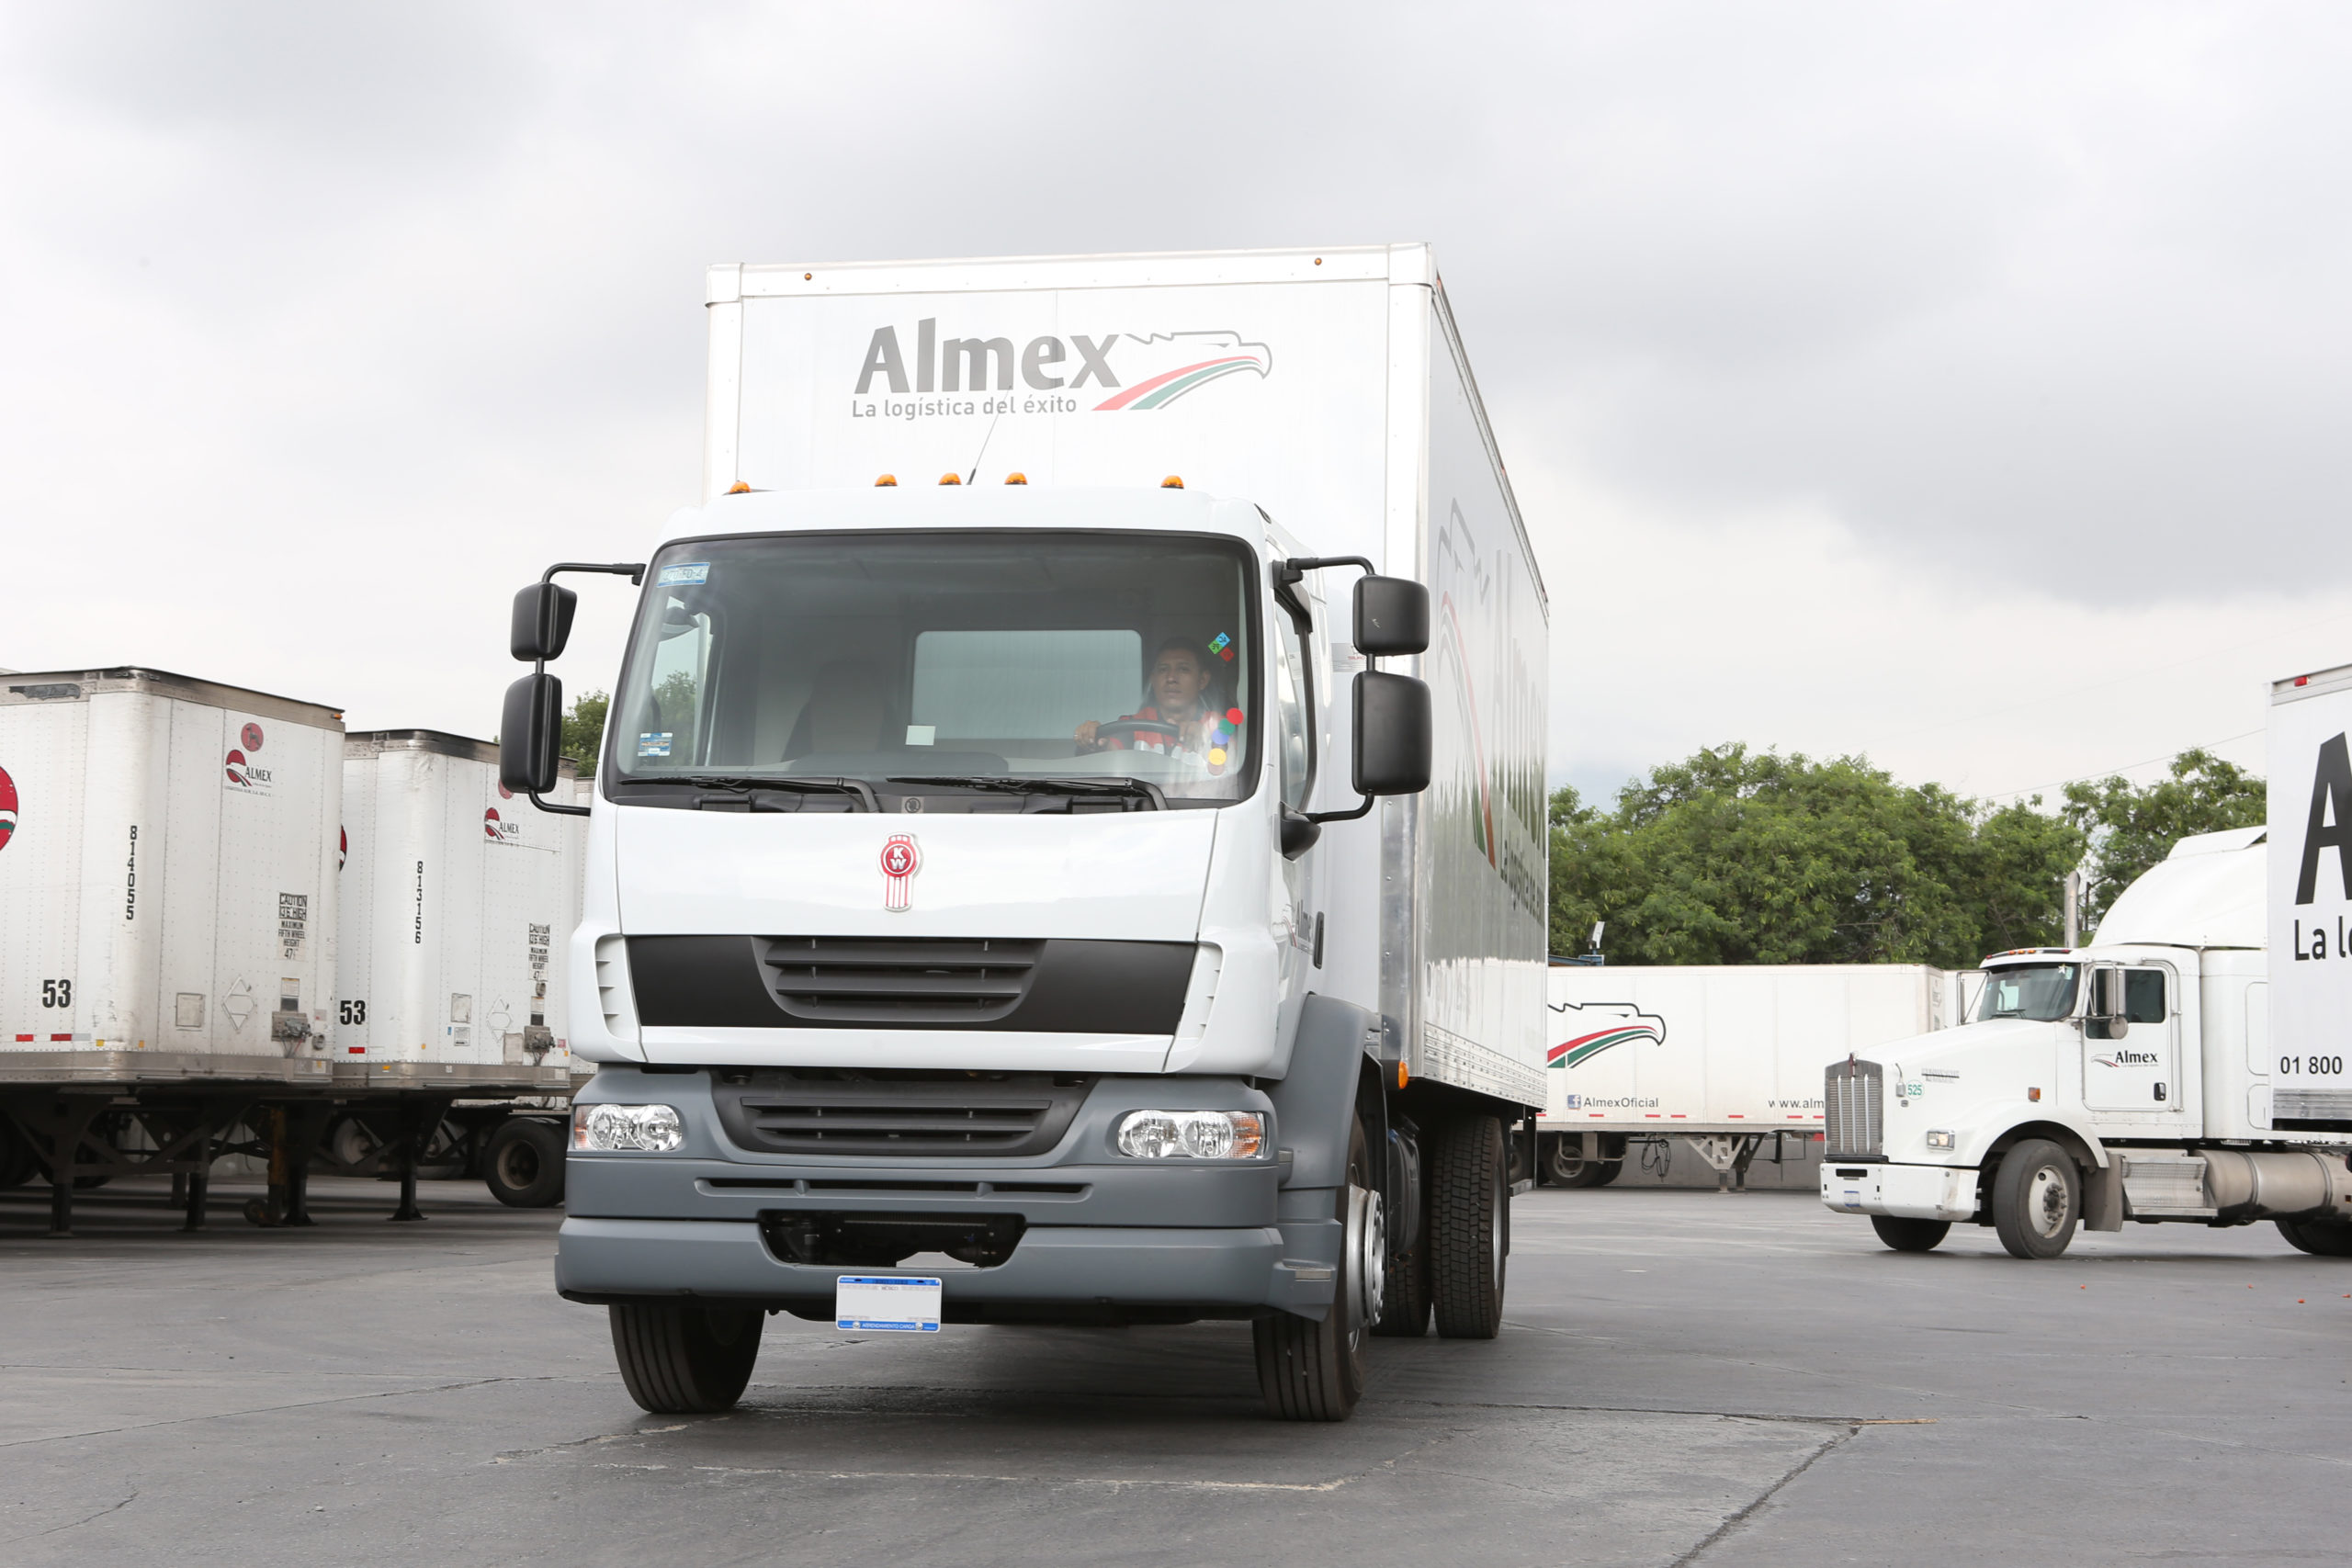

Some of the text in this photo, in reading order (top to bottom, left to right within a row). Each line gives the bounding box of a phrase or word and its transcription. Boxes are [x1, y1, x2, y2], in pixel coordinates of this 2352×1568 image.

[854, 317, 1121, 394] Almex
[853, 395, 1077, 421] La logística del éxito
[245, 766, 272, 783] ALMEX
[499, 822, 520, 834] ALMEX
[126, 825, 138, 920] 814055
[279, 893, 307, 907] CAUTION
[414, 860, 424, 944] 813156
[2295, 916, 2352, 962] La l
[42, 979, 72, 1009] 53
[340, 999, 366, 1025] 53
[2115, 1050, 2158, 1063] Almex
[2279, 1055, 2343, 1075] 01 800
[1907, 1084, 1923, 1096] 525
[1583, 1097, 1659, 1109] AlmexOficial
